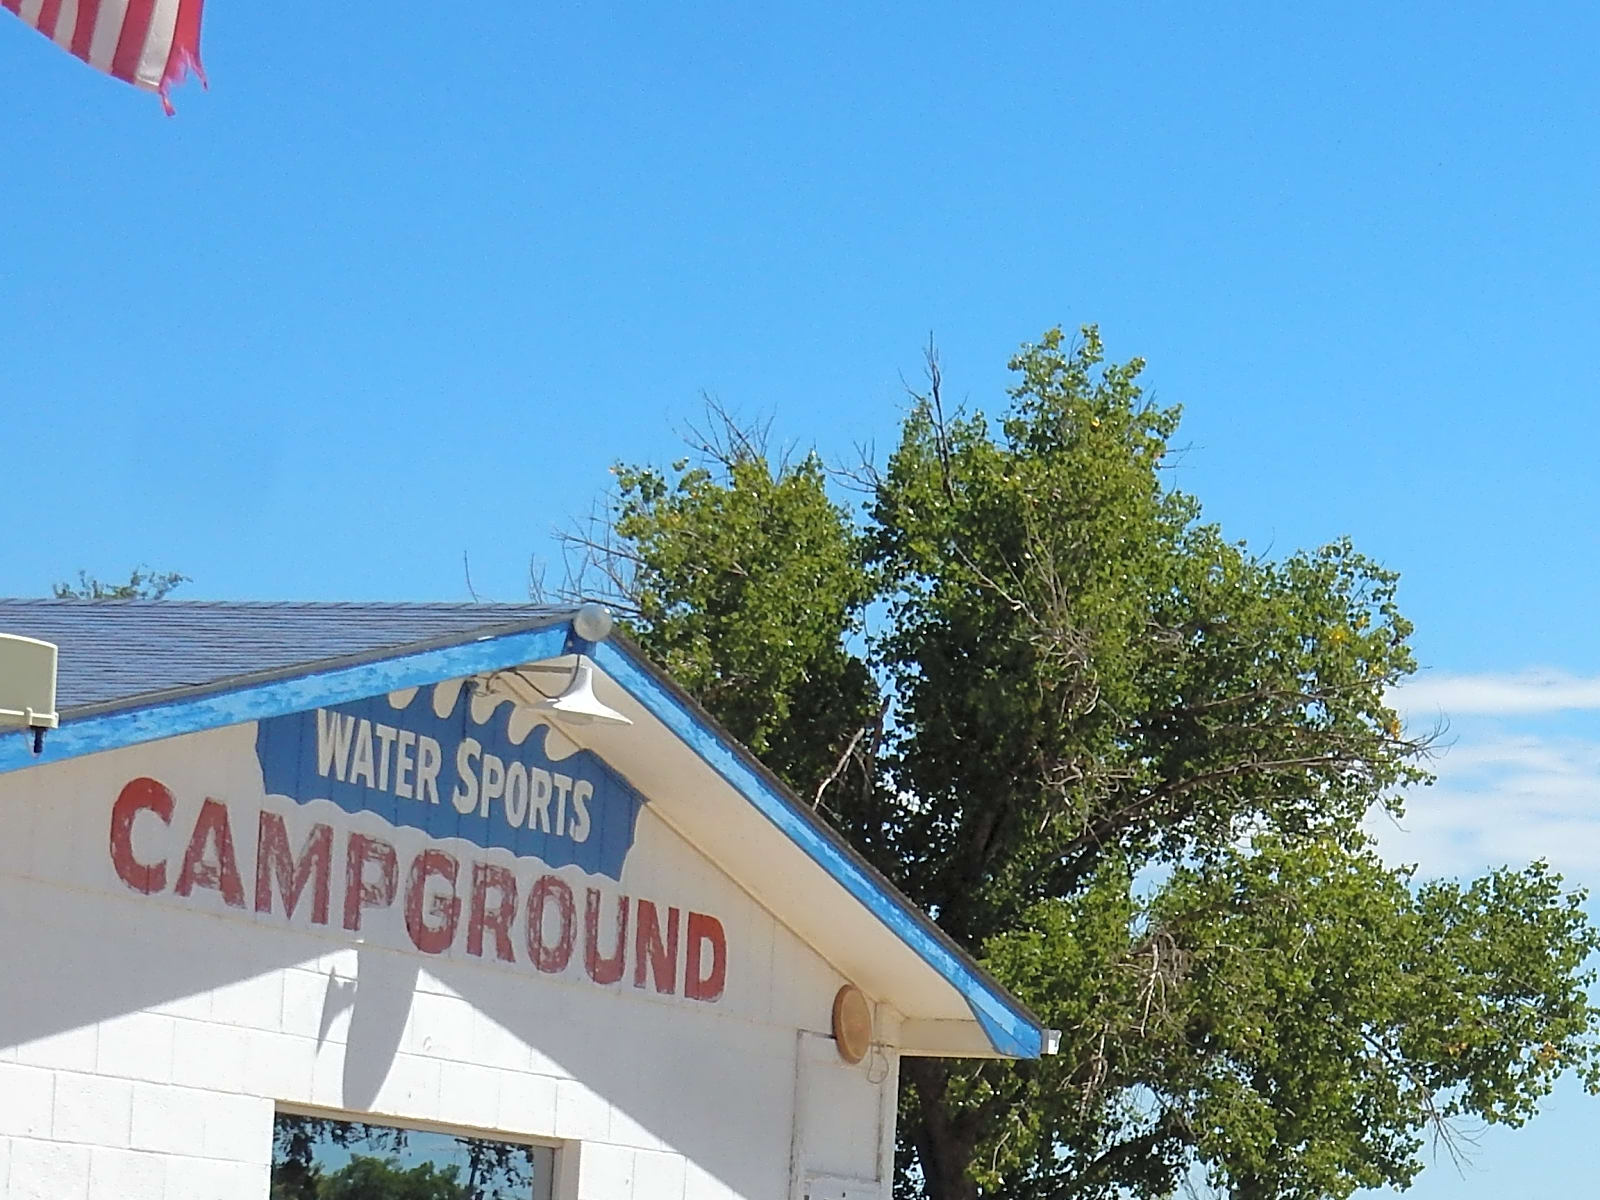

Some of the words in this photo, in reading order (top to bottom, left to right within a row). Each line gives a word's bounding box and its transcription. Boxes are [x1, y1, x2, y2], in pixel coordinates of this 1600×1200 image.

[315, 708, 442, 804] WATER
[452, 737, 594, 843] SPORTS
[110, 776, 728, 1003] CAMPGROUND
